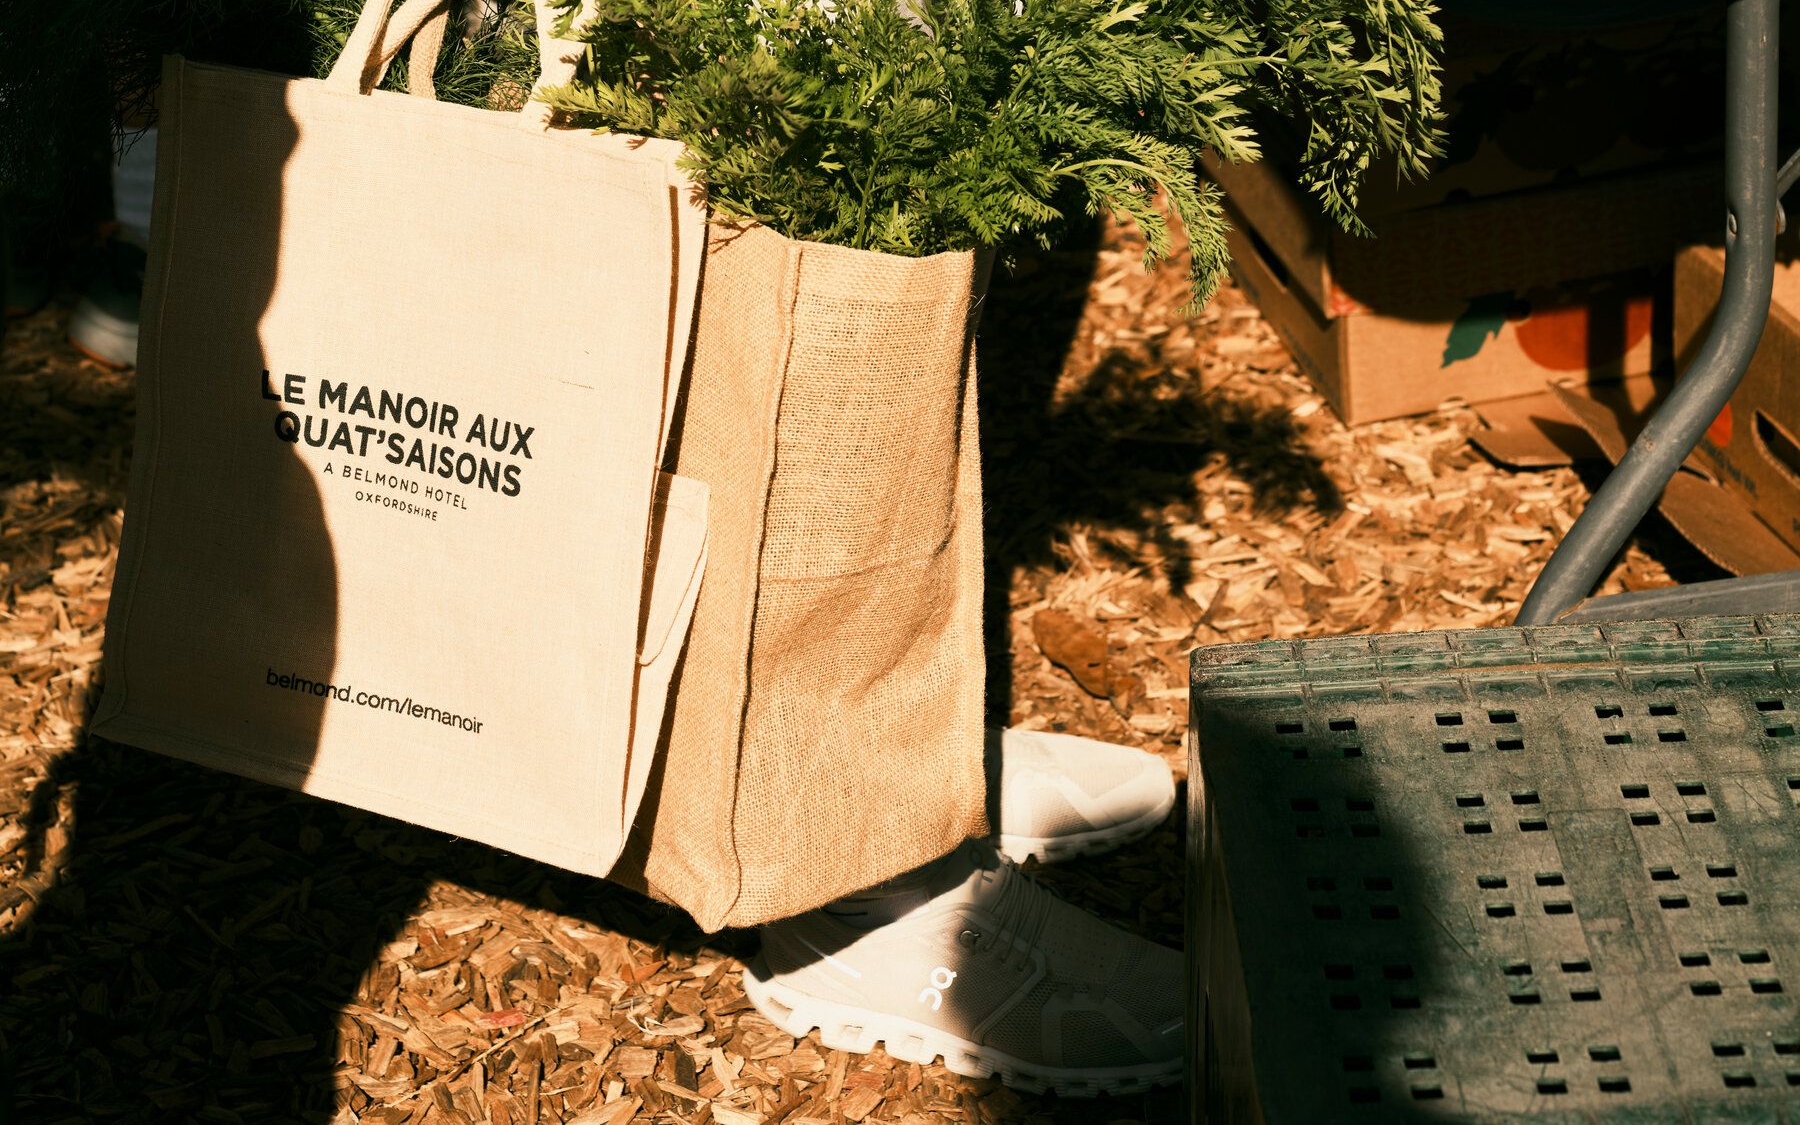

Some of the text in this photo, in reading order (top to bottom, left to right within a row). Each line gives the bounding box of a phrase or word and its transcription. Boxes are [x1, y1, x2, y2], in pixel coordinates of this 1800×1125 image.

[261, 369, 536, 460] LE MANOIR AUX
[274, 410, 522, 498] QUAT'SAISONS
[323, 462, 468, 511] A BELMOND HOTEL
[355, 490, 439, 522] OXFORDSHIRE
[266, 667, 484, 734] belmond.com/lemanoir
